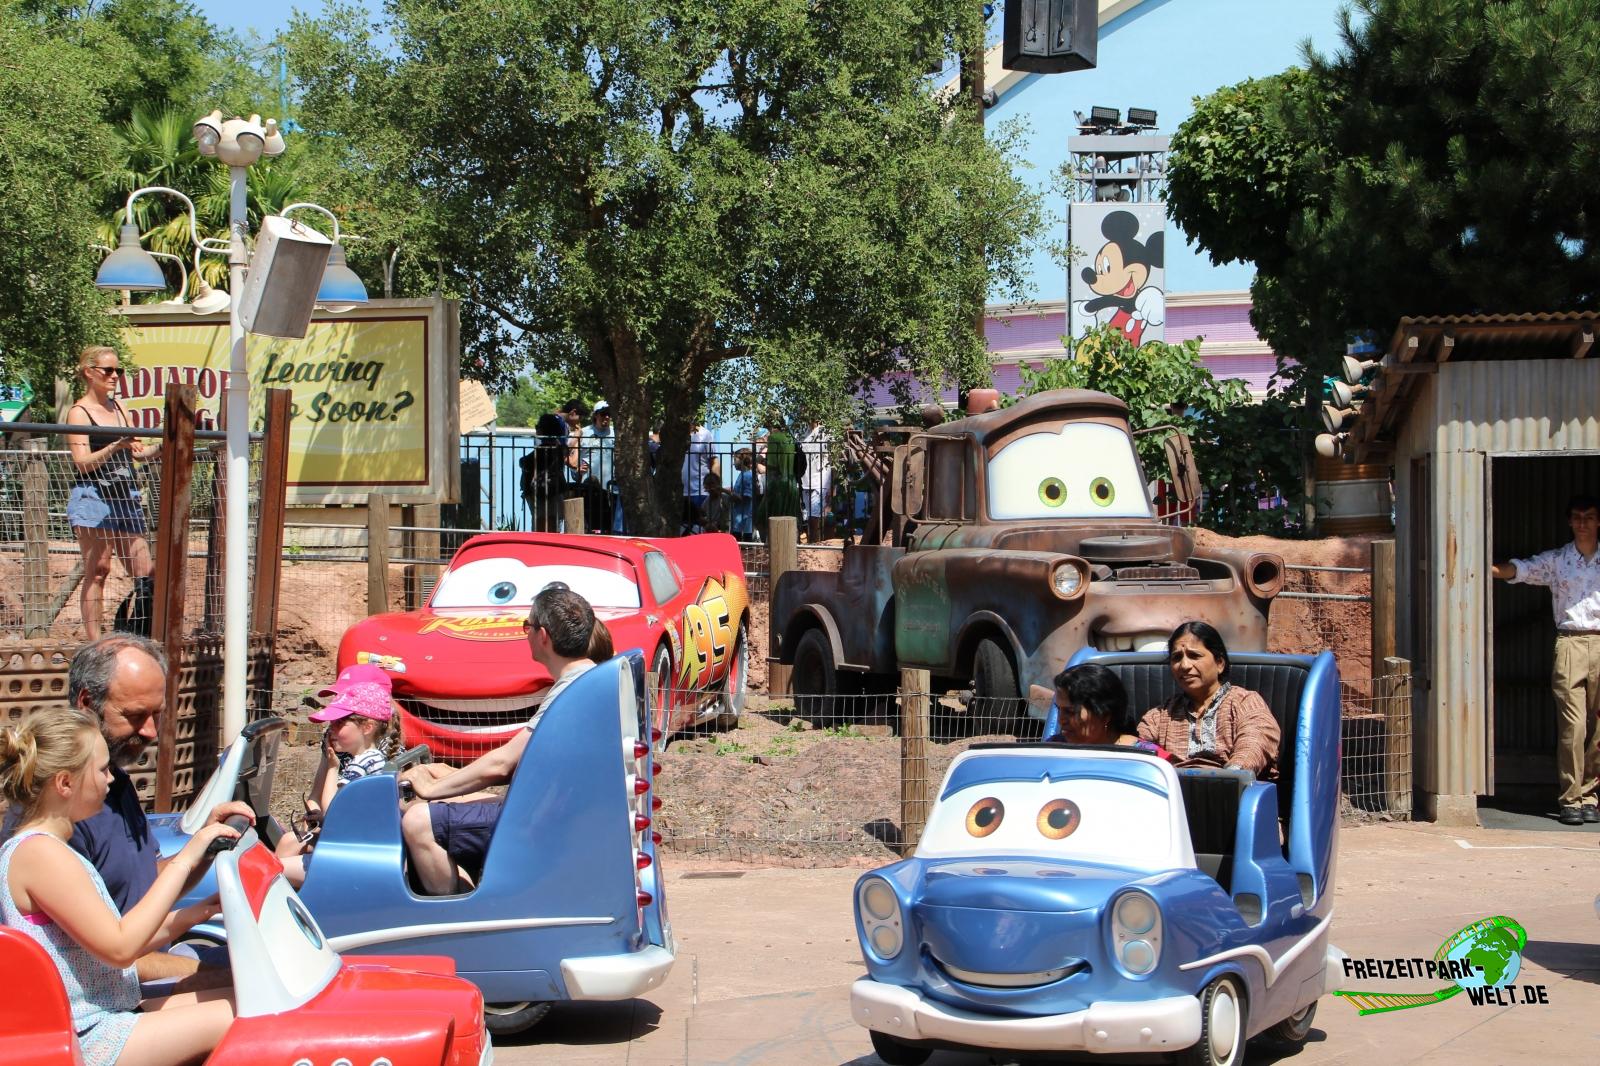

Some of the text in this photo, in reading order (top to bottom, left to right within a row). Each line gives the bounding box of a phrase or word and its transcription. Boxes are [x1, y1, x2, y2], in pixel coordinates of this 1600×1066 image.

[261, 353, 385, 391] Leaving
[306, 390, 414, 423] Soon?
[686, 596, 731, 690] 95
